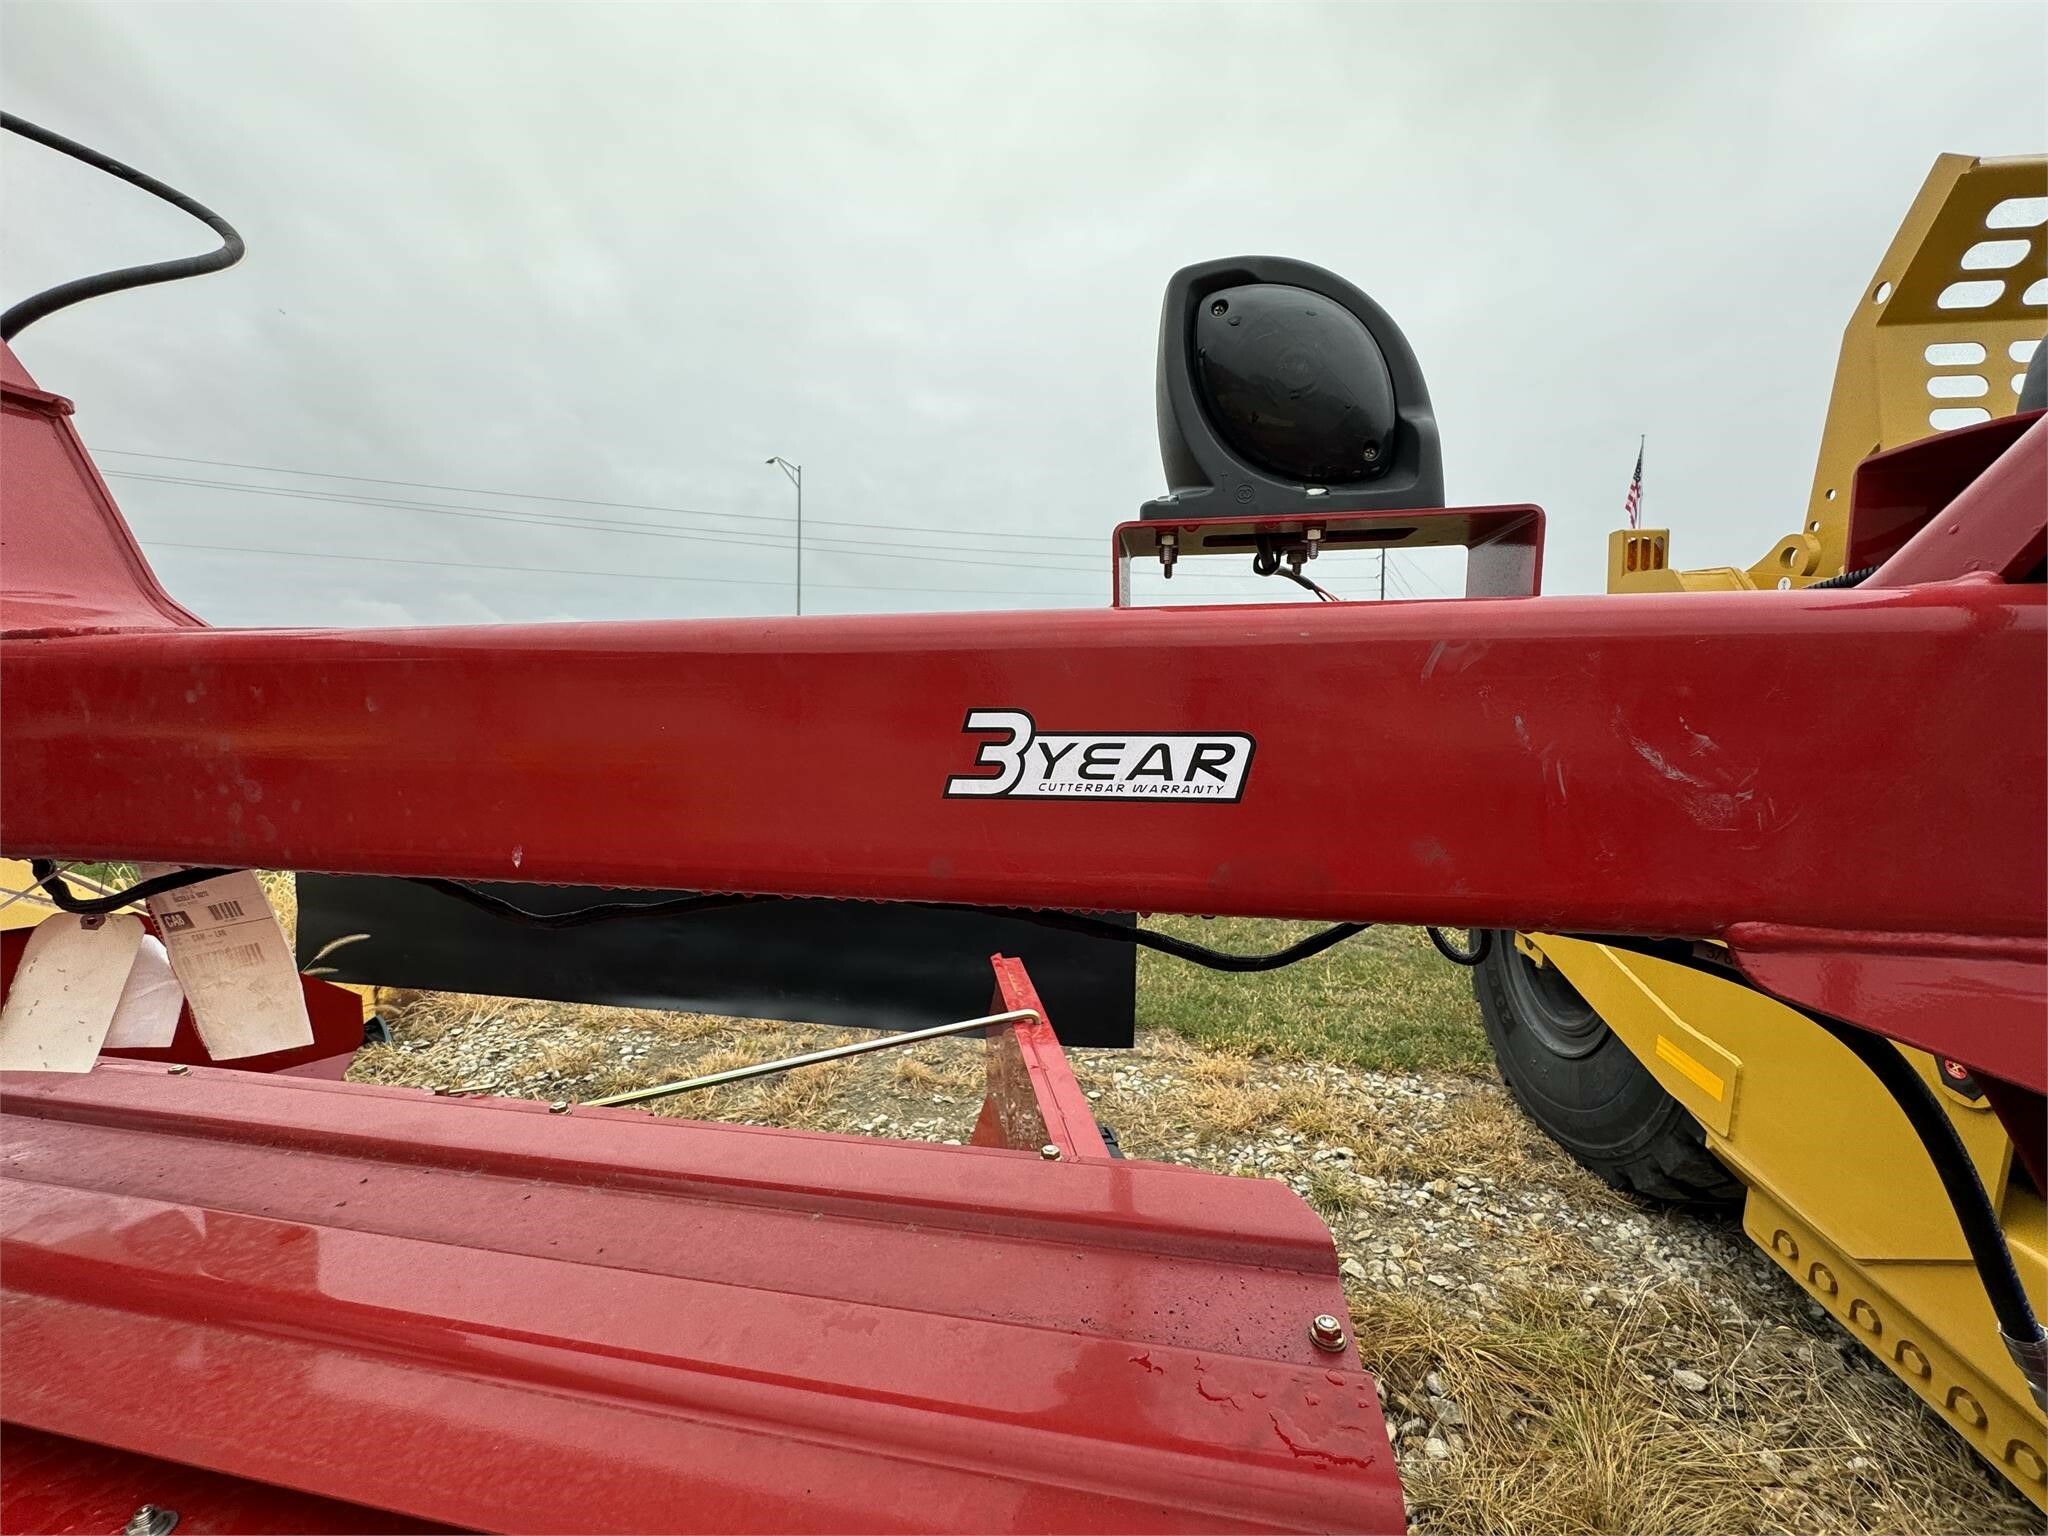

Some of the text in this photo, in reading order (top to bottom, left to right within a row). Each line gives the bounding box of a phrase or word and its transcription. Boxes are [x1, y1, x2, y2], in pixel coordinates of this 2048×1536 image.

[946, 710, 1236, 796] 3 YEAR
[1038, 782, 1226, 795] CUTTERBAR WARRANTY
